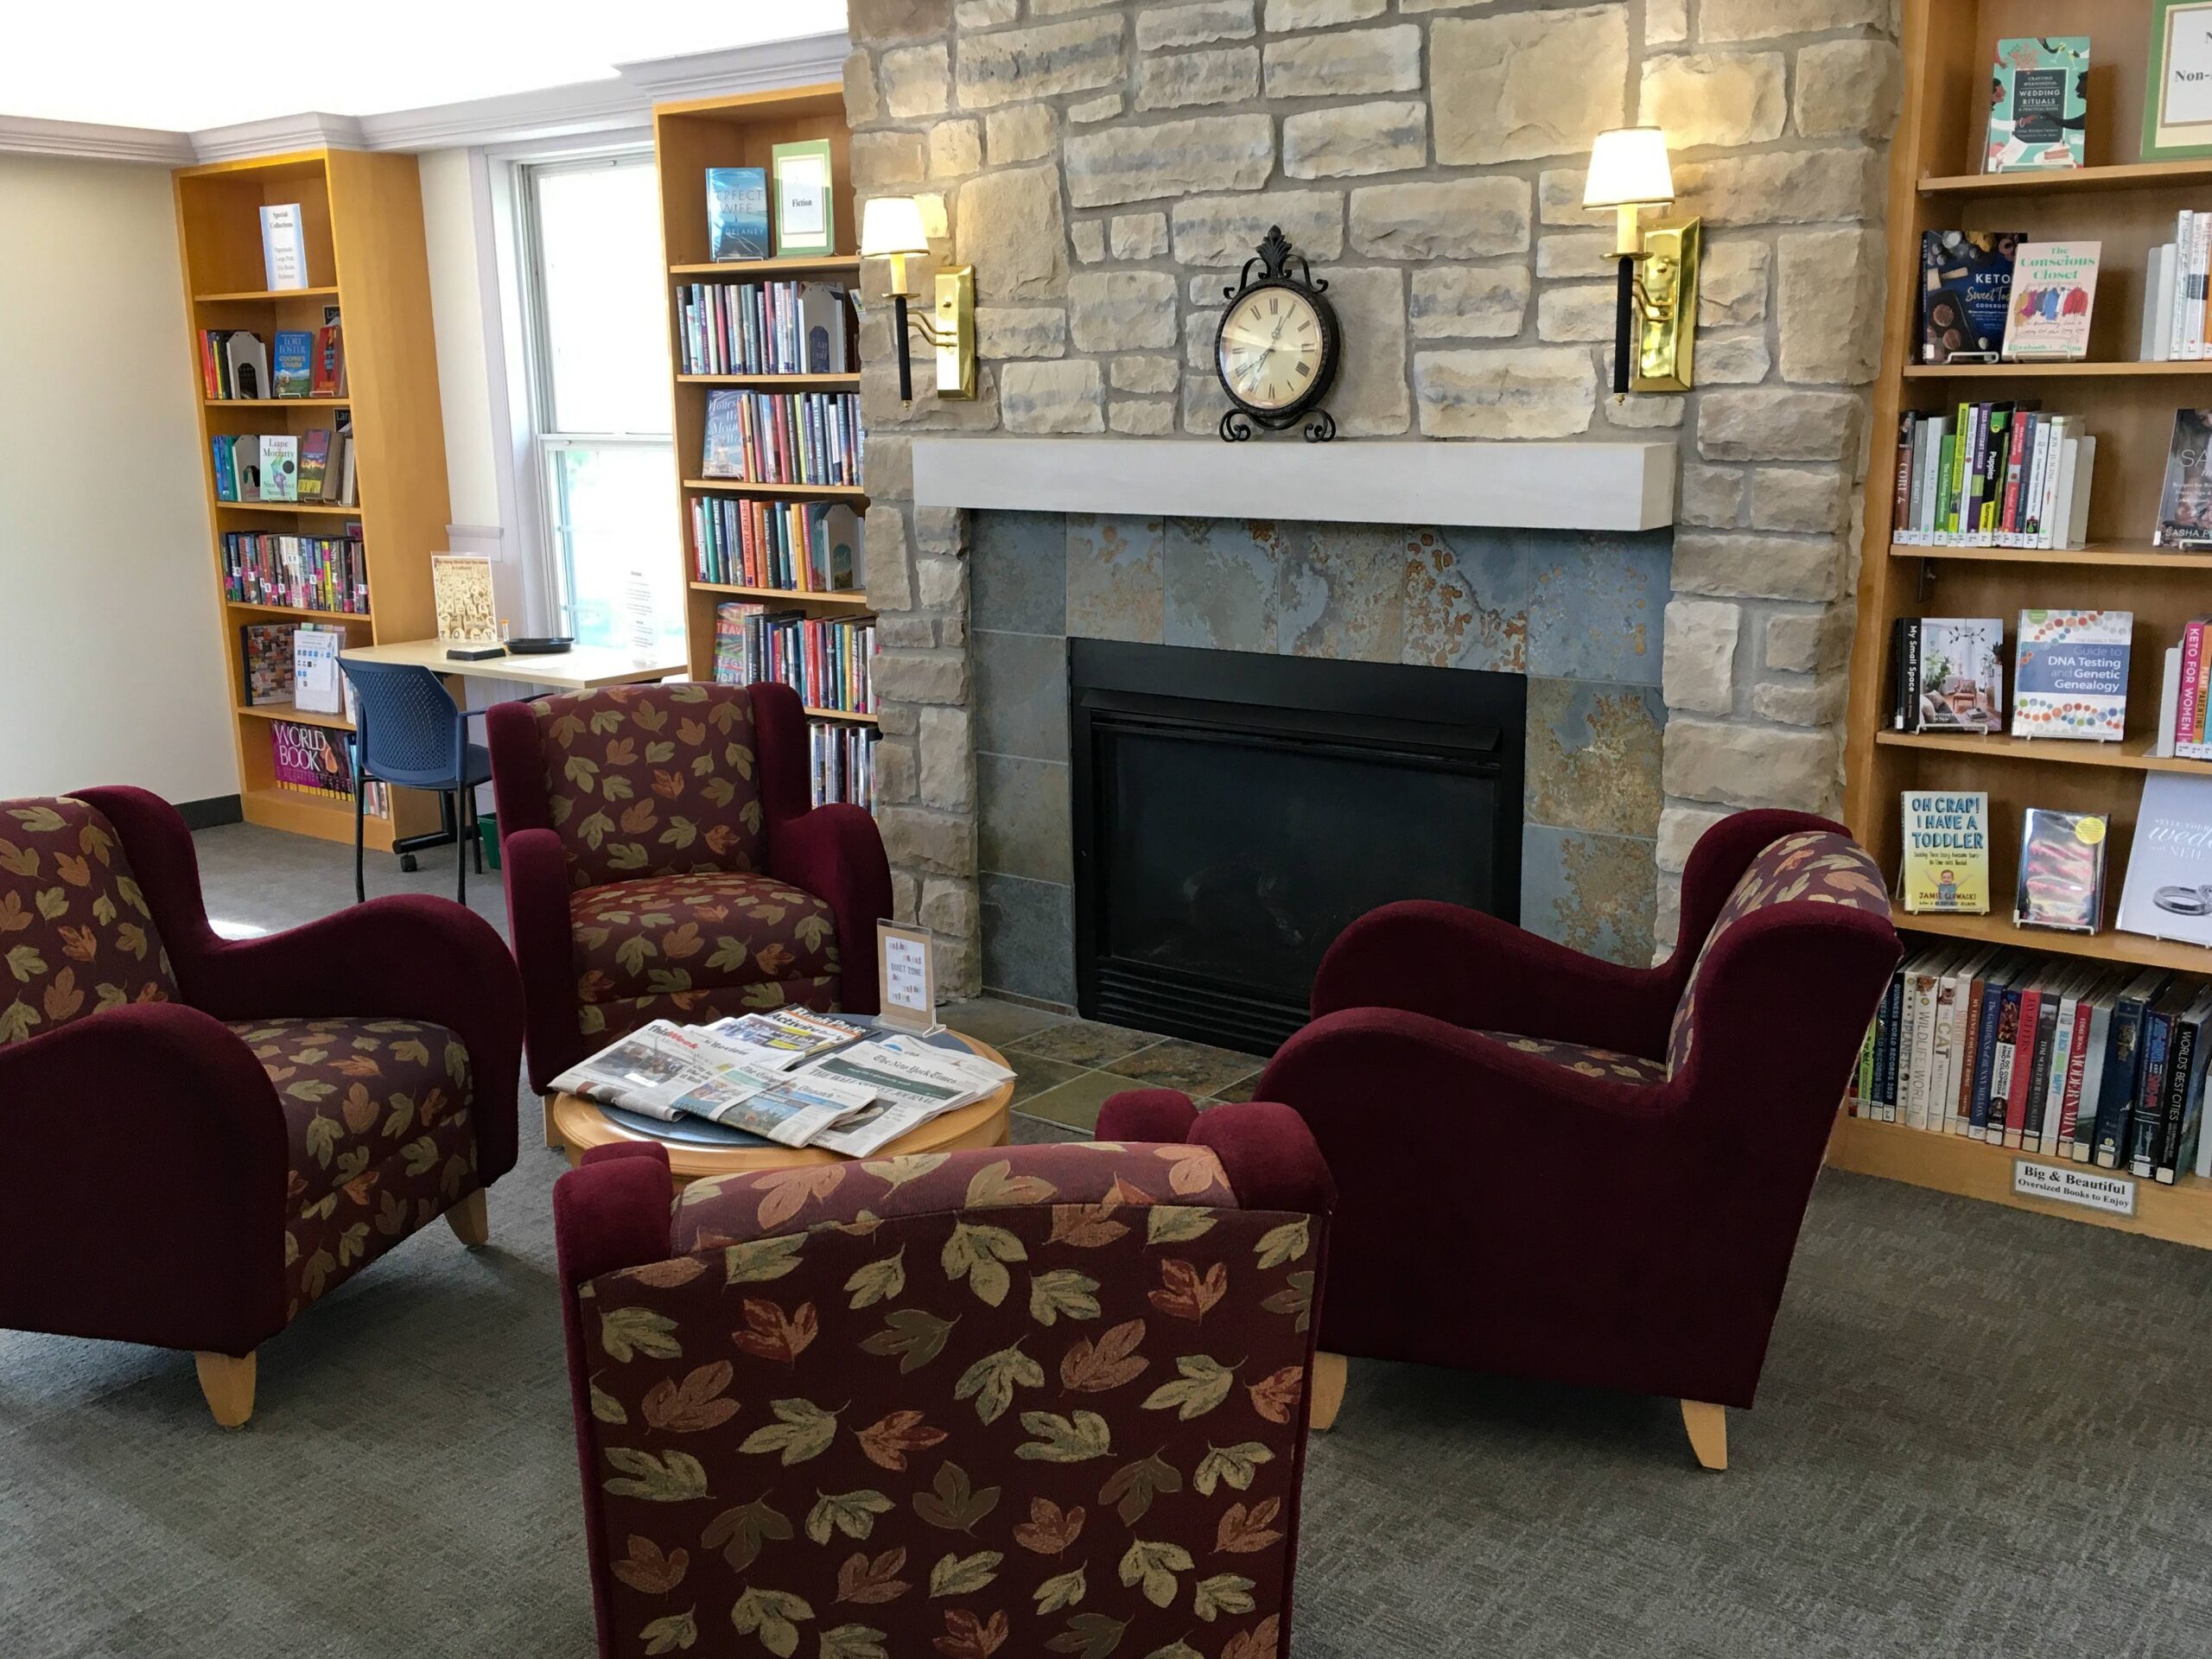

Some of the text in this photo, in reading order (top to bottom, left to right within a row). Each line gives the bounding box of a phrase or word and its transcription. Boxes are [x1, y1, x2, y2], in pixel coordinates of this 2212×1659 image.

[721, 203, 753, 214] WIFE
[791, 199, 812, 207] Fiction
[2020, 256, 2095, 267] Conscious
[1975, 274, 2011, 283] KETO
[2032, 270, 2078, 280] Closet
[1965, 286, 1996, 302] Sweet
[279, 346, 306, 354] FOSTER
[1979, 410, 1988, 450] DEER-RESISTANT
[264, 448, 294, 459] Moriarty
[269, 438, 289, 448] Liane
[1897, 463, 1908, 491] CORE
[1953, 458, 1962, 490] gardening
[1986, 451, 1998, 480] Puppies
[2048, 454, 2056, 481] JUICING
[1941, 474, 1949, 497] Lifelong
[2005, 486, 2016, 506] Annabel
[741, 502, 752, 563] PETER JAMES
[2165, 529, 2200, 537] SASHA
[1908, 626, 1917, 639] My
[1909, 640, 1917, 664] Small
[2048, 657, 2121, 670] DNA Testing
[2074, 645, 2122, 657] Guide to
[1907, 666, 1916, 692] Space
[2050, 668, 2120, 679] and Genetic
[2055, 679, 2120, 692] Genealogy
[2181, 628, 2199, 731] KETO FOR WOMEN
[2195, 666, 2209, 729] PLANT PARENTING
[274, 724, 327, 751] WORLD
[279, 745, 321, 772] BOOK
[1912, 797, 1980, 814] OH CRAP!
[1917, 815, 1978, 830] I HAVE A
[1912, 832, 1984, 849] TODDLER
[891, 963, 922, 976] QUIET ZONE
[1972, 998, 1979, 1007] MY
[2025, 998, 2036, 1012] JAY
[769, 1014, 819, 1033] Activity
[1890, 1020, 1898, 1046] WORLD
[1969, 1009, 1978, 1035] FRENCH
[1983, 1014, 1995, 1050] GARDENS
[2020, 1014, 2034, 1052] JEFFERS
[648, 1025, 700, 1050] ThisWeek
[711, 1041, 749, 1056] Review
[1899, 1025, 1913, 1070] PLANETS
[1935, 1021, 1952, 1058] CAT
[2177, 1030, 2191, 1070] WORLD'S
[1888, 1047, 1897, 1080] RECORDS
[1910, 1011, 1931, 1110] WILDLIFE WORLD
[1965, 1037, 1974, 1066] COUNTRY
[1983, 1051, 1991, 1059] of
[2051, 1031, 2069, 1095] BEACH HAPPY
[740, 1065, 755, 1074] The
[873, 1054, 958, 1084] The New York Times
[1874, 1048, 1885, 1081] RECORDS
[1980, 1058, 1990, 1085] BUNNY
[1996, 1046, 2008, 1096] ENCYCLOPEDIA
[2005, 1060, 2010, 1070] DC
[2061, 1017, 2088, 1135] EDDIE ROSS MODERN MIX
[808, 1068, 937, 1105] THE WALL STREET JOURNAL
[1963, 1068, 1972, 1087] HOME
[2173, 1071, 2185, 1093] BEST
[1975, 1086, 1986, 1118] MELLON
[2169, 1094, 2182, 1122] CITIES
[2024, 1166, 2126, 1195] Big & Beautiful
[2018, 1179, 2129, 1208] Oversized Books to Enjoy
